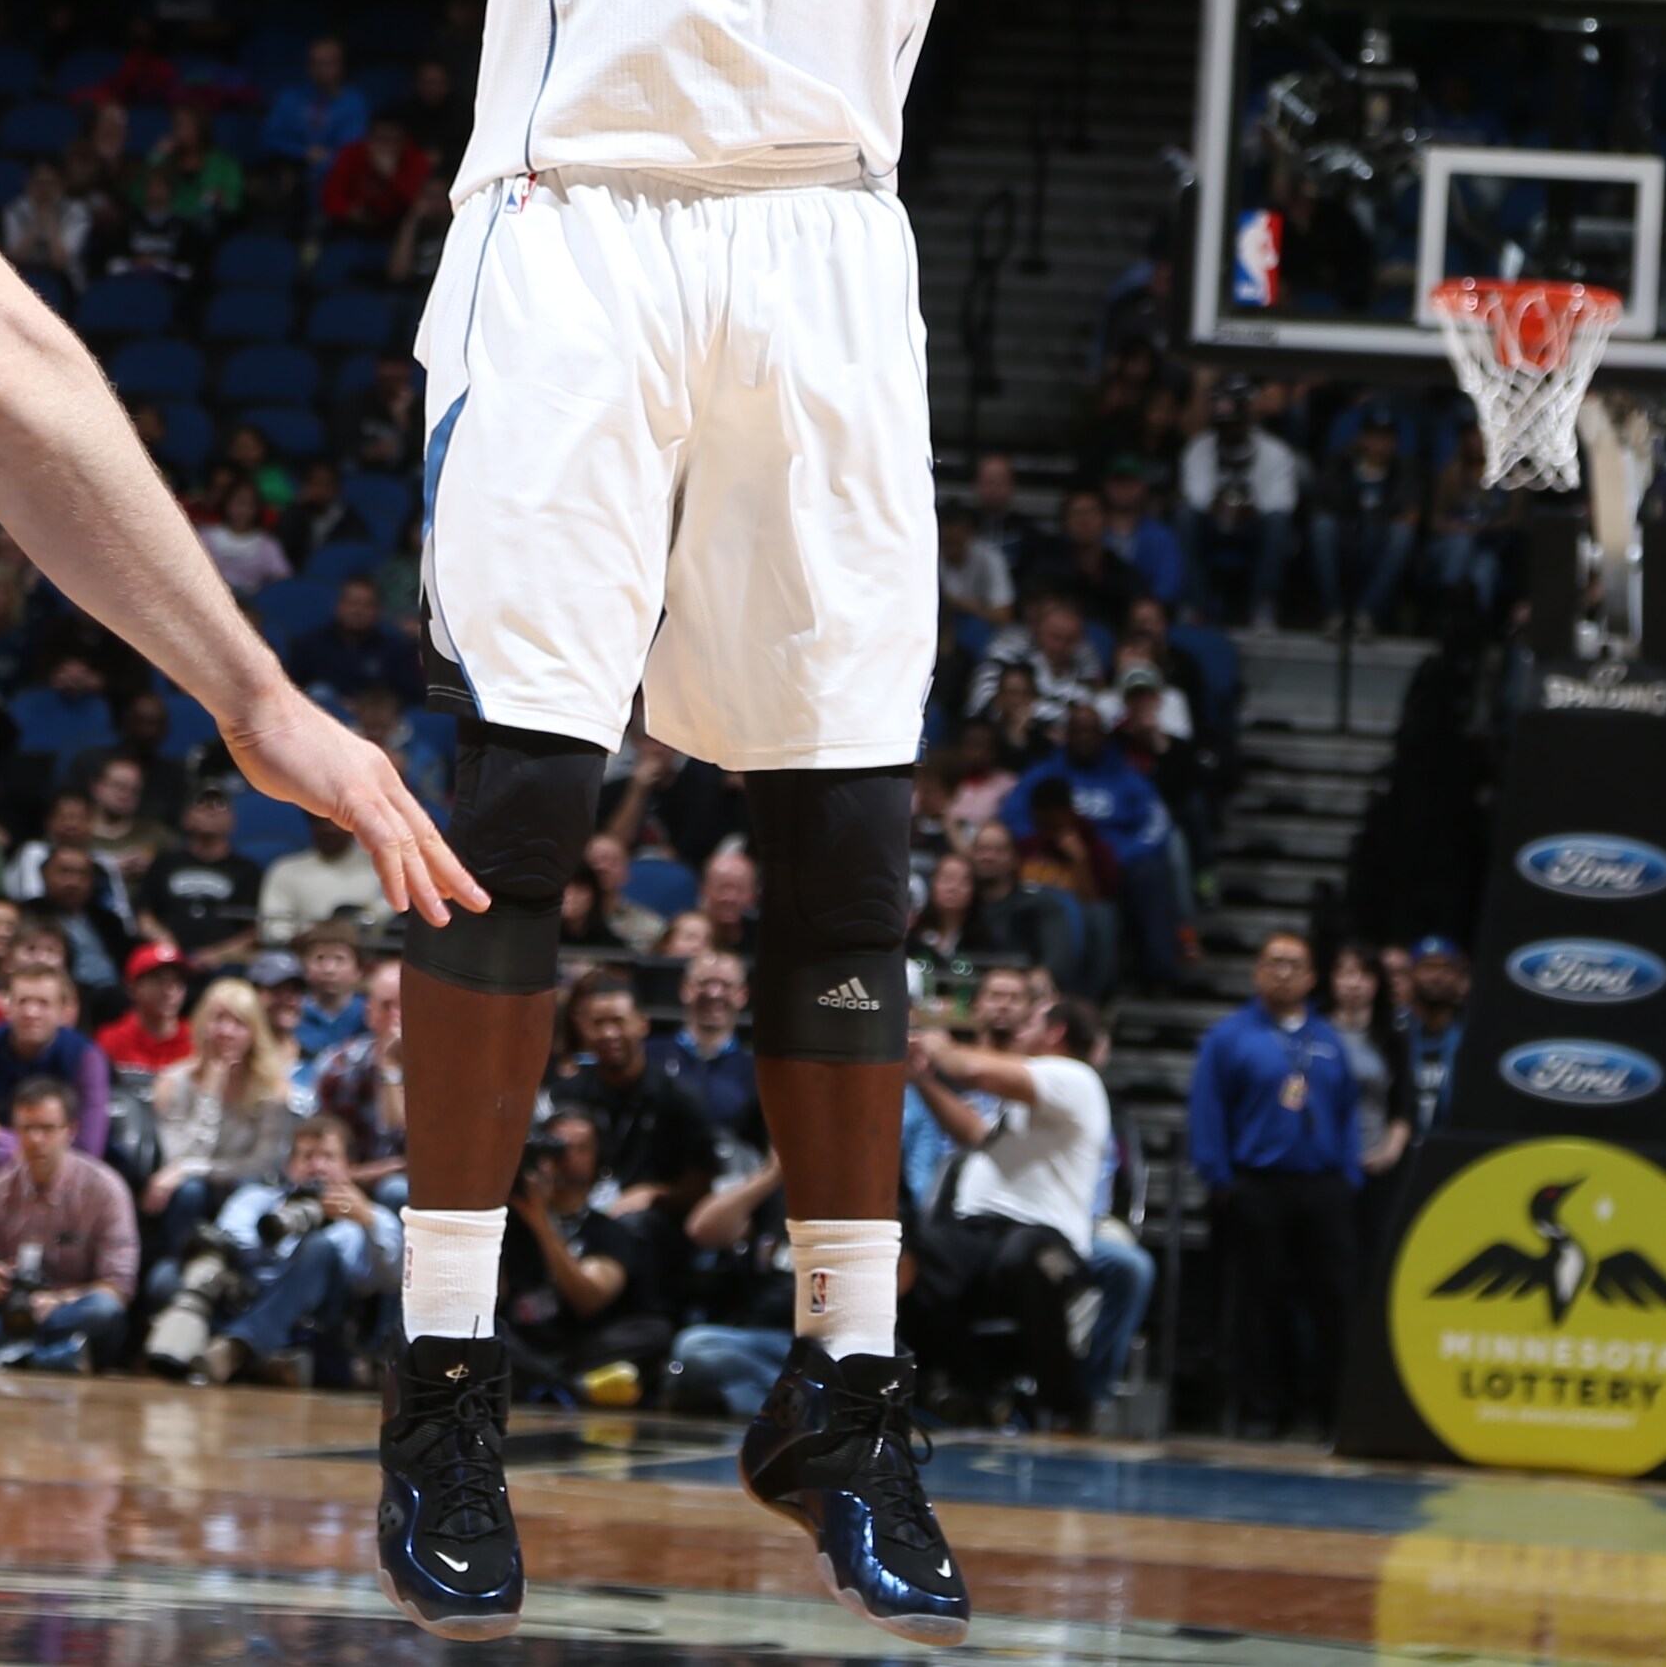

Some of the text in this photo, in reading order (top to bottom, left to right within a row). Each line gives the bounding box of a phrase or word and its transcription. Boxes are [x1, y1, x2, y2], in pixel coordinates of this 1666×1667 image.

[1544, 848, 1646, 892] Ford
[1534, 952, 1636, 996] Ford
[817, 993, 881, 1011] adidas
[1526, 1052, 1629, 1097] Ford
[1462, 1369, 1665, 1412] LOTTERY
